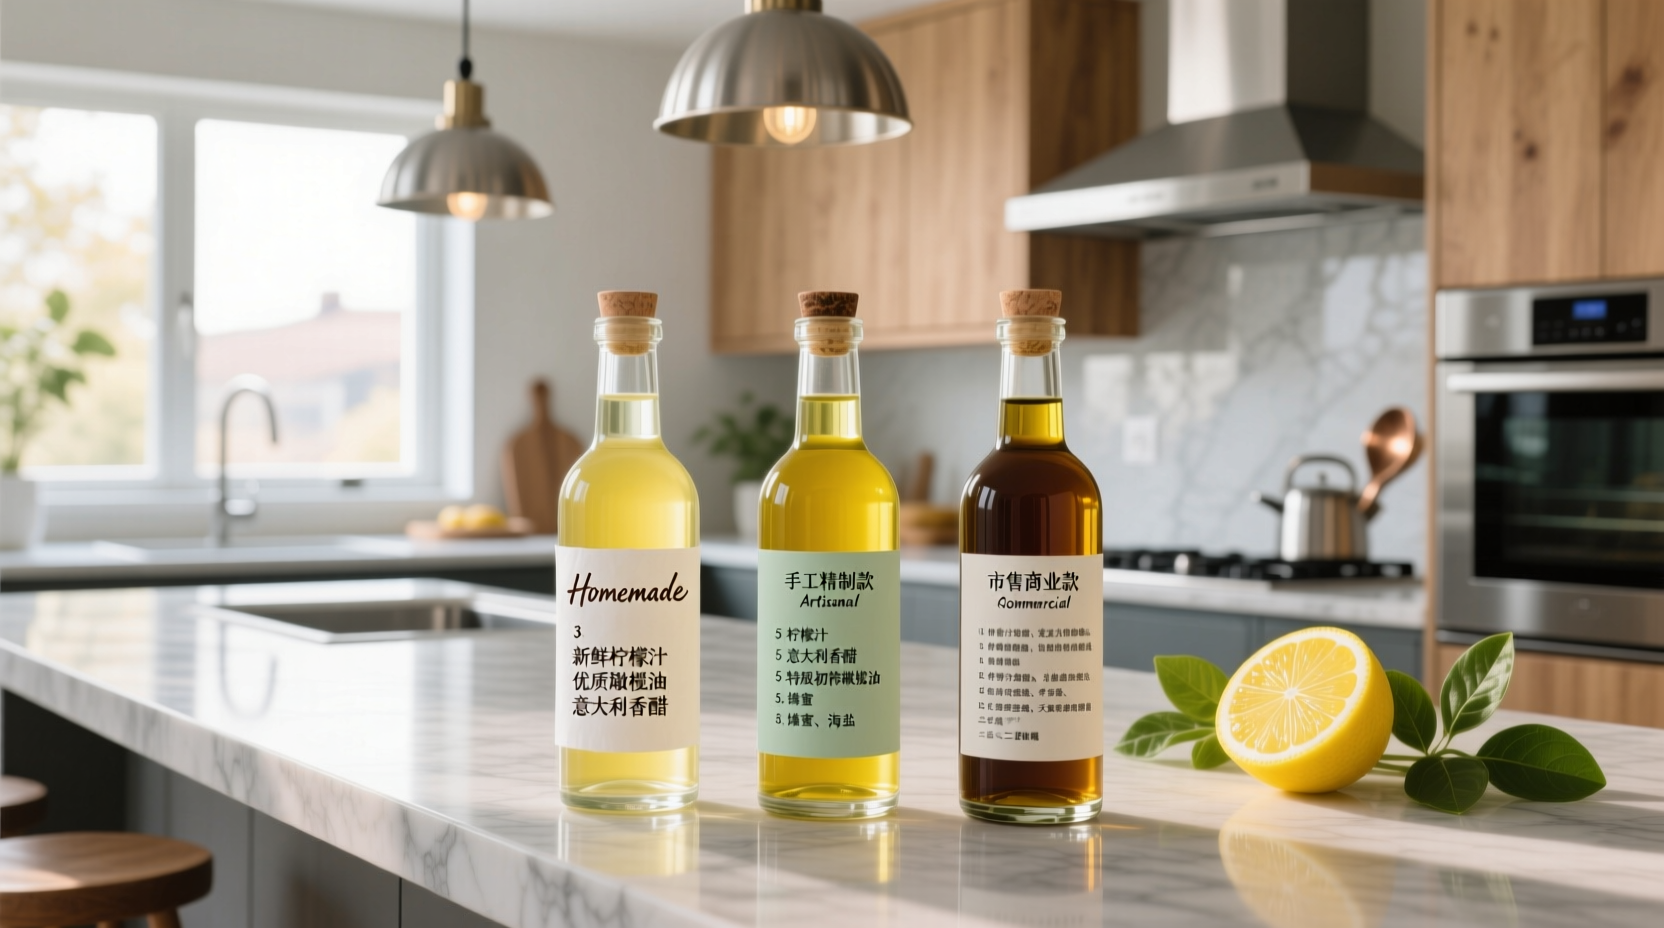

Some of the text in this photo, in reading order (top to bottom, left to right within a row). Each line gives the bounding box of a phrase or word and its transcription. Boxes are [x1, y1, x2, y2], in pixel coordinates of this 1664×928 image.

[567, 572, 689, 608] Homemade
[784, 571, 874, 592] 手工精制款
[987, 570, 1080, 592] 市售商业款
[572, 645, 668, 669] 新鲜柠檬汁
[572, 694, 669, 718] 意大利香醋
